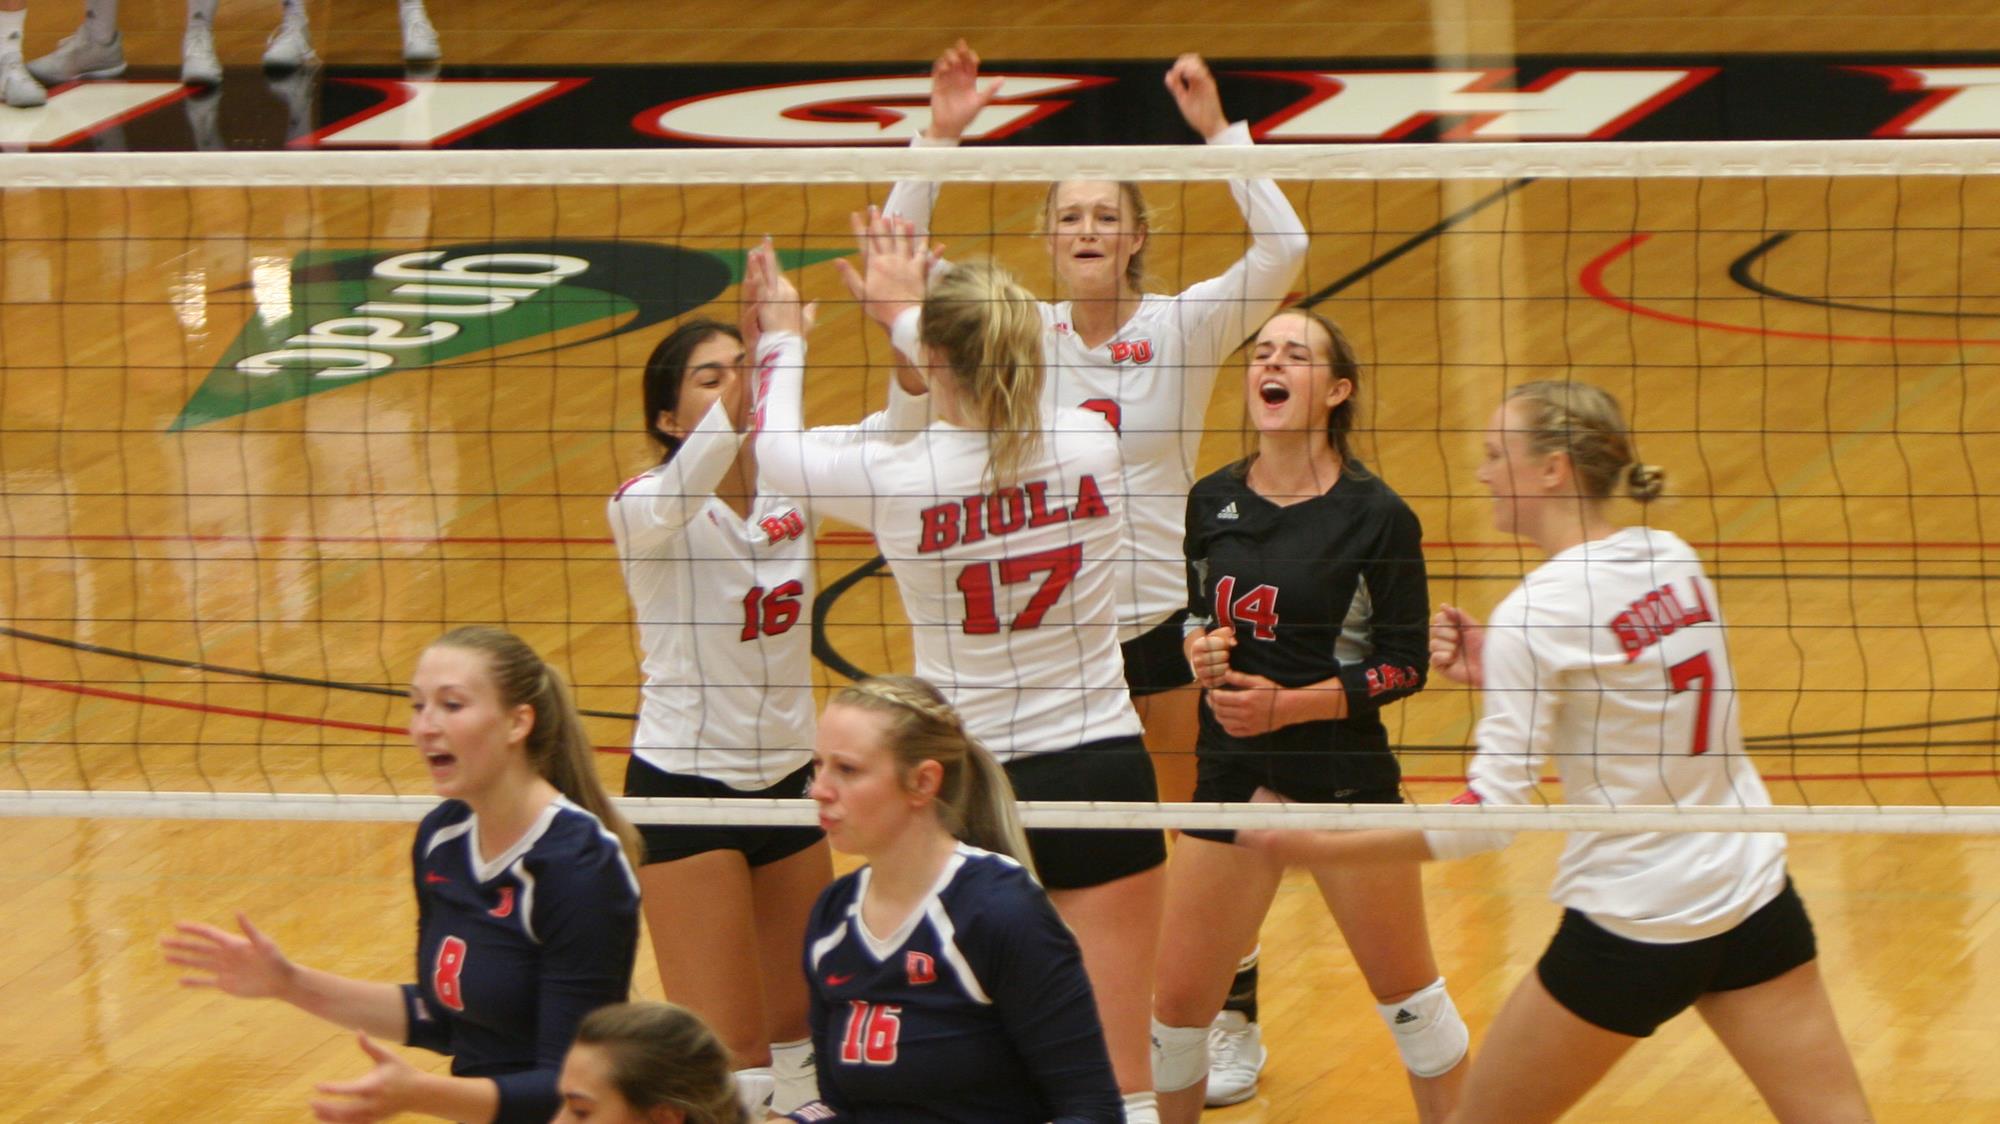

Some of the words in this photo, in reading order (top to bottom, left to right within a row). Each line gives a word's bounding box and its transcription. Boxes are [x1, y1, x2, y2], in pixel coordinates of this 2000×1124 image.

[1107, 338, 1154, 364] BU
[917, 474, 1110, 554] BIOLA
[740, 579, 803, 642] 16
[956, 541, 1083, 635] 17
[1215, 575, 1279, 641] 14
[1669, 651, 1714, 757] 7
[434, 935, 467, 1011] 8
[906, 950, 938, 985] D
[840, 1000, 902, 1065] 16
